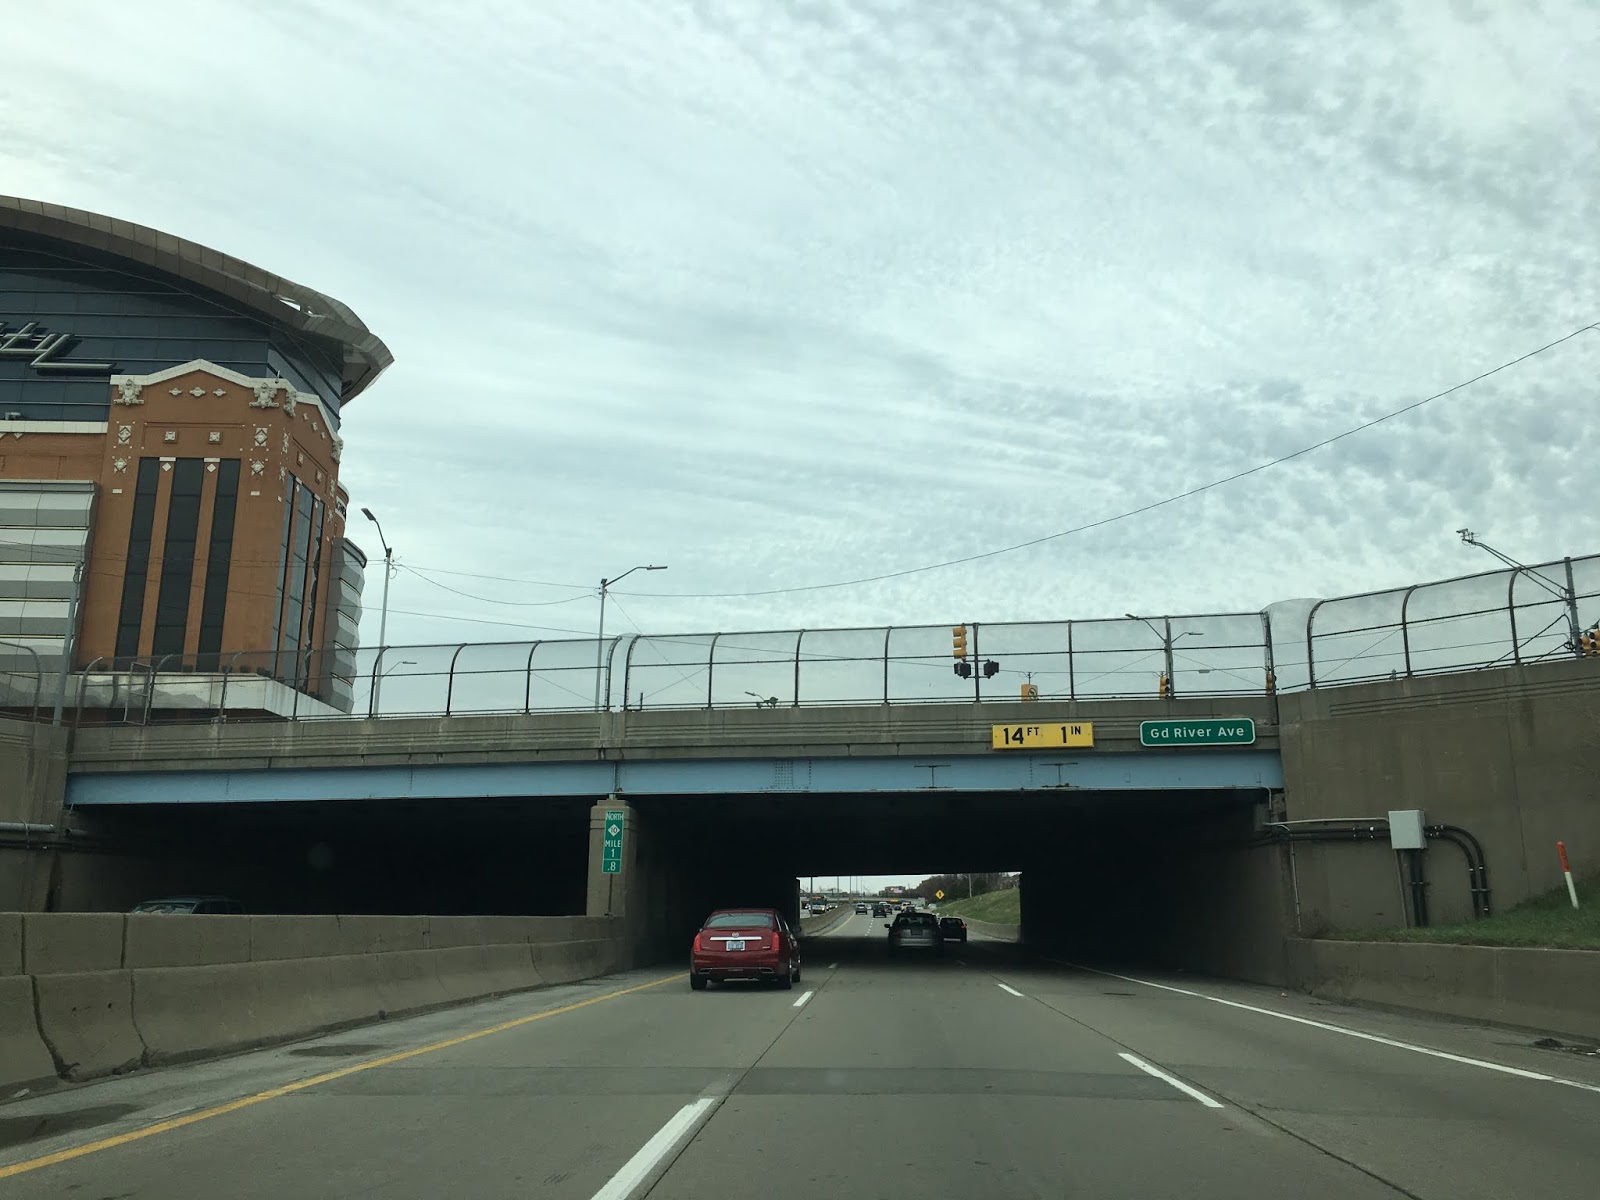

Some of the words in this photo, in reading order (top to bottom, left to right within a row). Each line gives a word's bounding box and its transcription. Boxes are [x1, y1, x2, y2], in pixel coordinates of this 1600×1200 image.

[1003, 727, 1024, 745] 14
[1027, 727, 1039, 736] FT
[1061, 726, 1067, 743] 1
[1071, 726, 1081, 735] IN
[1150, 728, 1169, 738] Gd
[1174, 727, 1211, 738] River
[1218, 727, 1244, 737] Ave
[606, 812, 623, 820] NORTH
[611, 848, 615, 858] 1
[607, 861, 616, 871] .8
